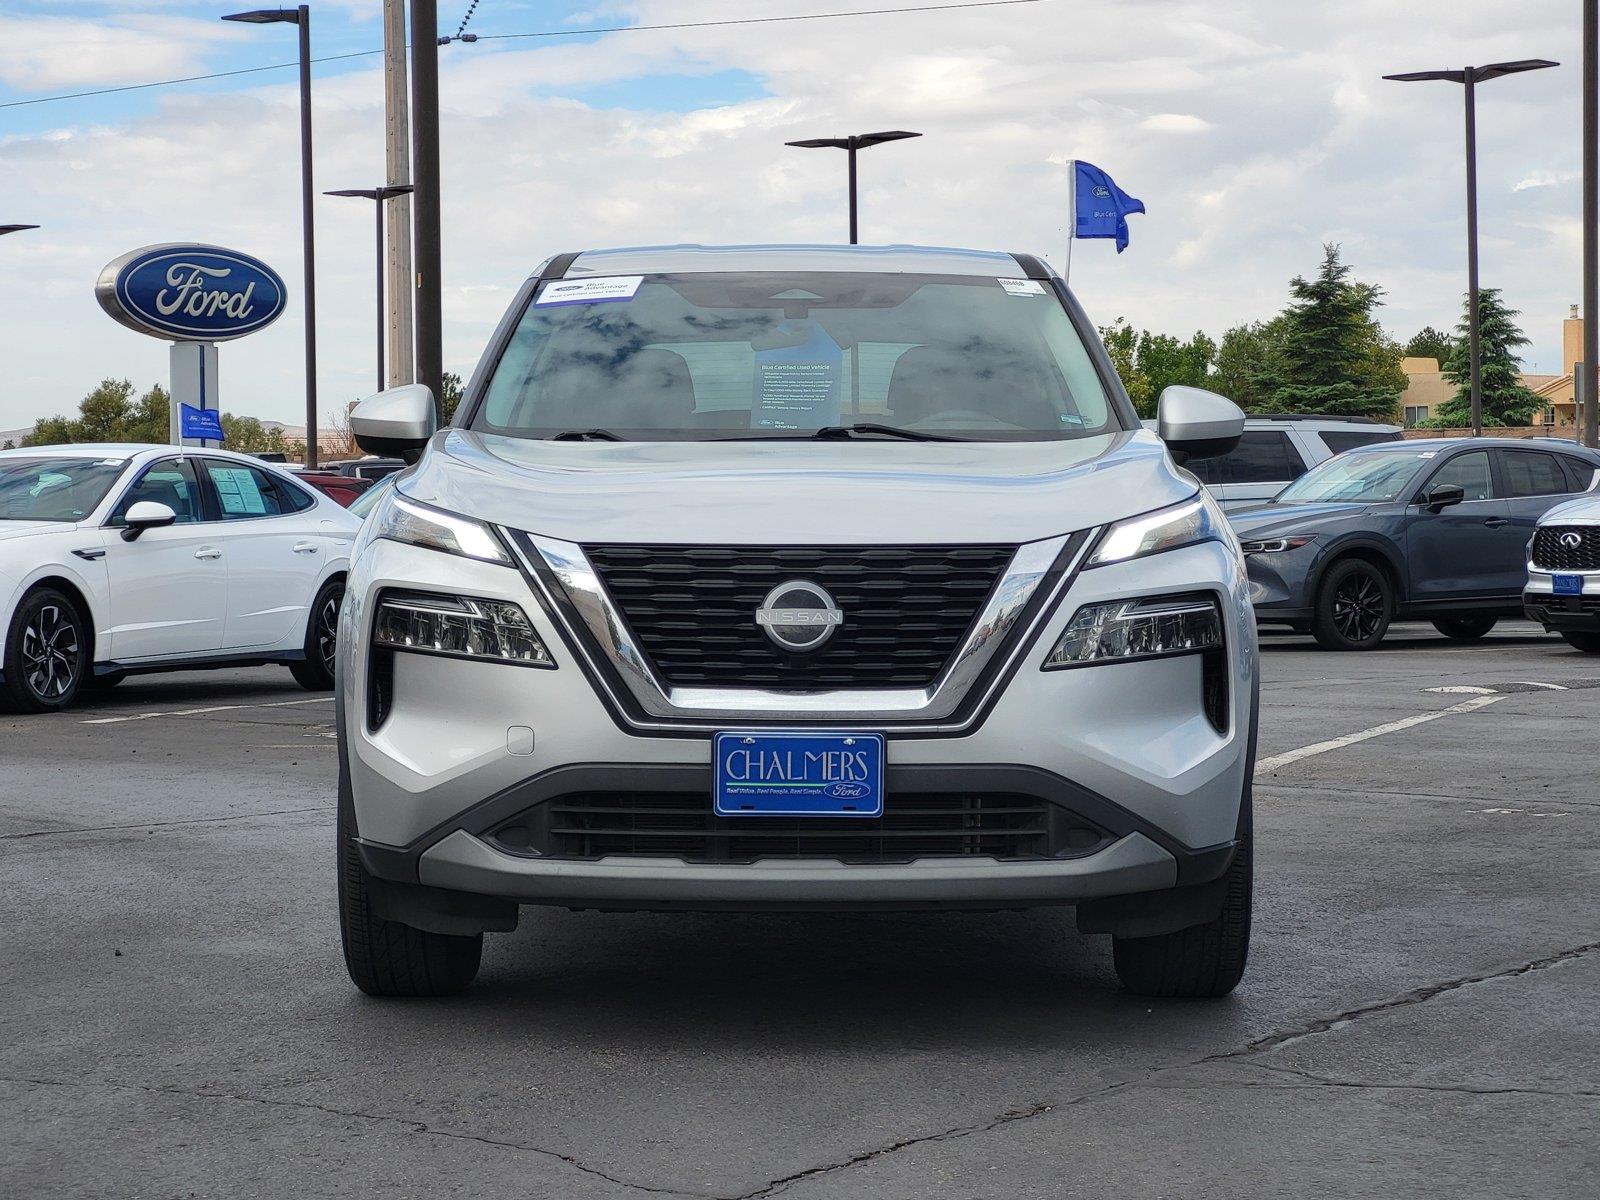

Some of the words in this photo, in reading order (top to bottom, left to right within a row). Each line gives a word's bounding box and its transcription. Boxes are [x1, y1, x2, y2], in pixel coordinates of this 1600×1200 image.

[156, 263, 256, 319] Ford
[760, 612, 840, 622] NISSAN
[725, 750, 868, 781] CHALMERS
[832, 784, 862, 797] Ford
